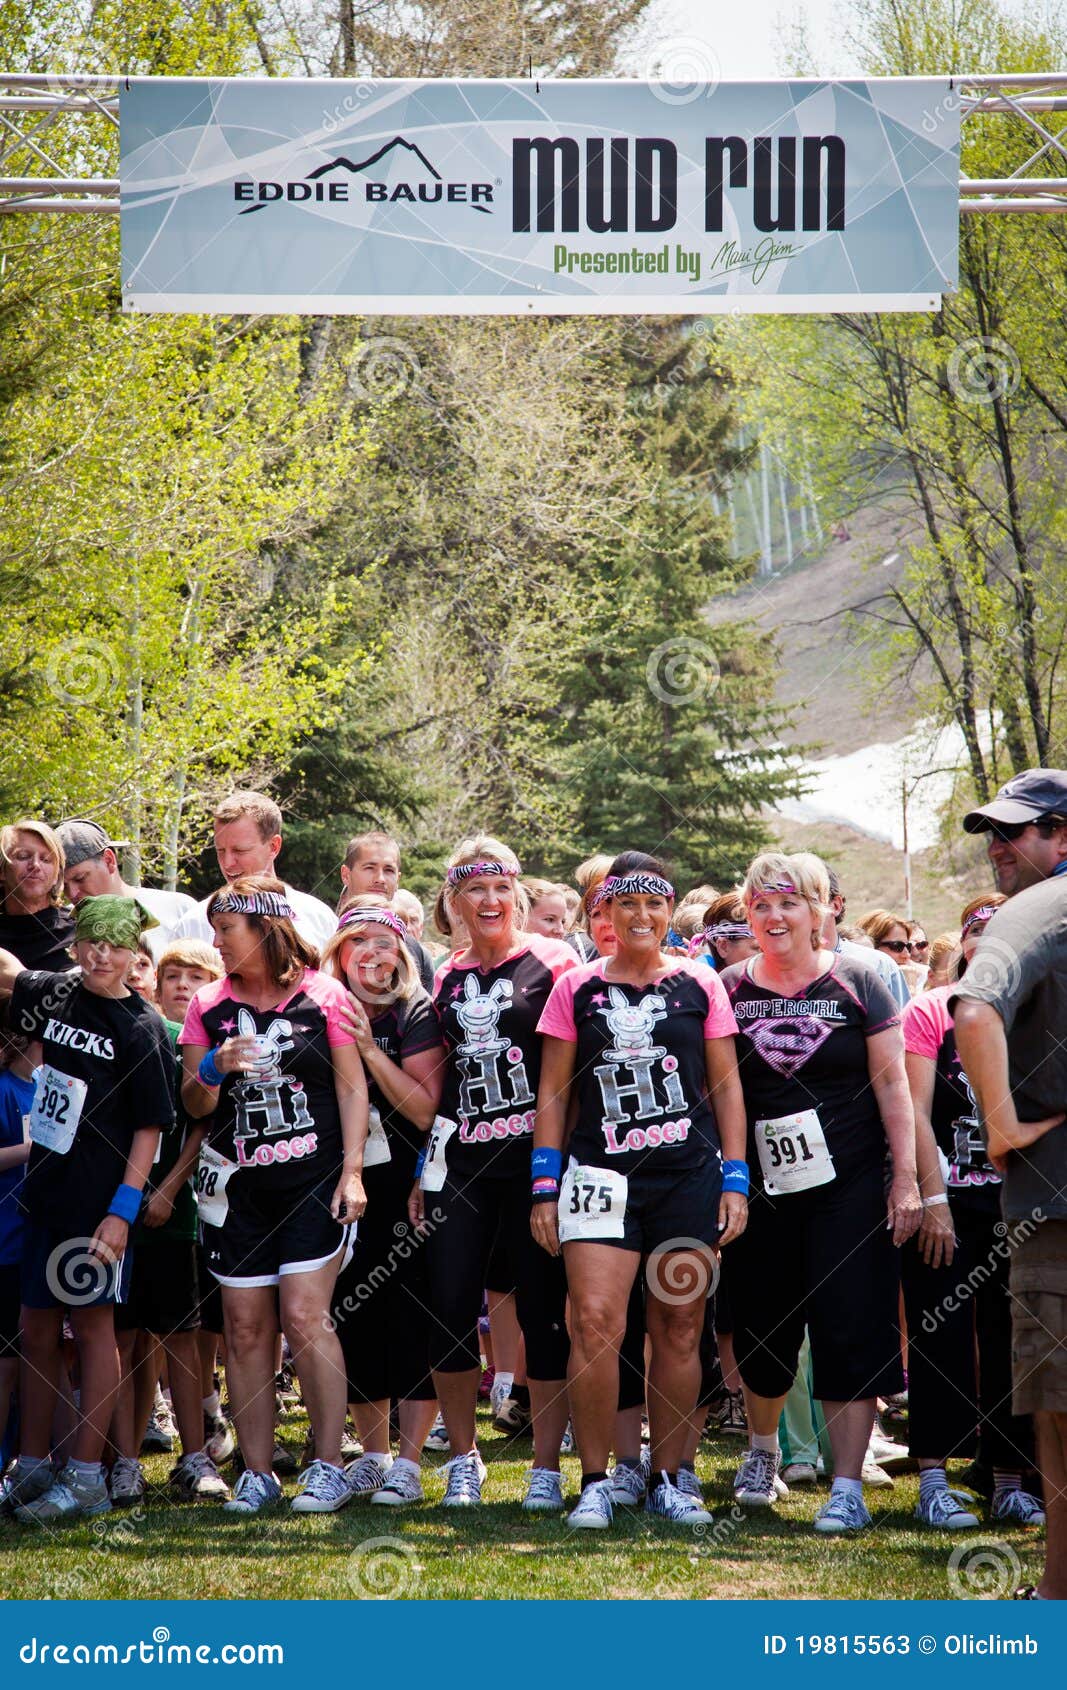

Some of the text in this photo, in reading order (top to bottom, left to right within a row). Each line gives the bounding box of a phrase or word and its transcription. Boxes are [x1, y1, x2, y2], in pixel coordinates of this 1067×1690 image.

[234, 182, 494, 202] EDDIE BAUER
[553, 245, 701, 282] Presented by
[734, 999, 843, 1020] SUPERGIRL
[456, 1046, 536, 1117] Hi
[594, 1055, 689, 1125] Hi
[38, 1084, 70, 1124] 392
[228, 1081, 315, 1138] Hi
[458, 1110, 537, 1144] Loser
[602, 1118, 692, 1154] Loser
[233, 1132, 319, 1167] Loser
[765, 1132, 814, 1167] 391
[570, 1184, 613, 1214] 375
